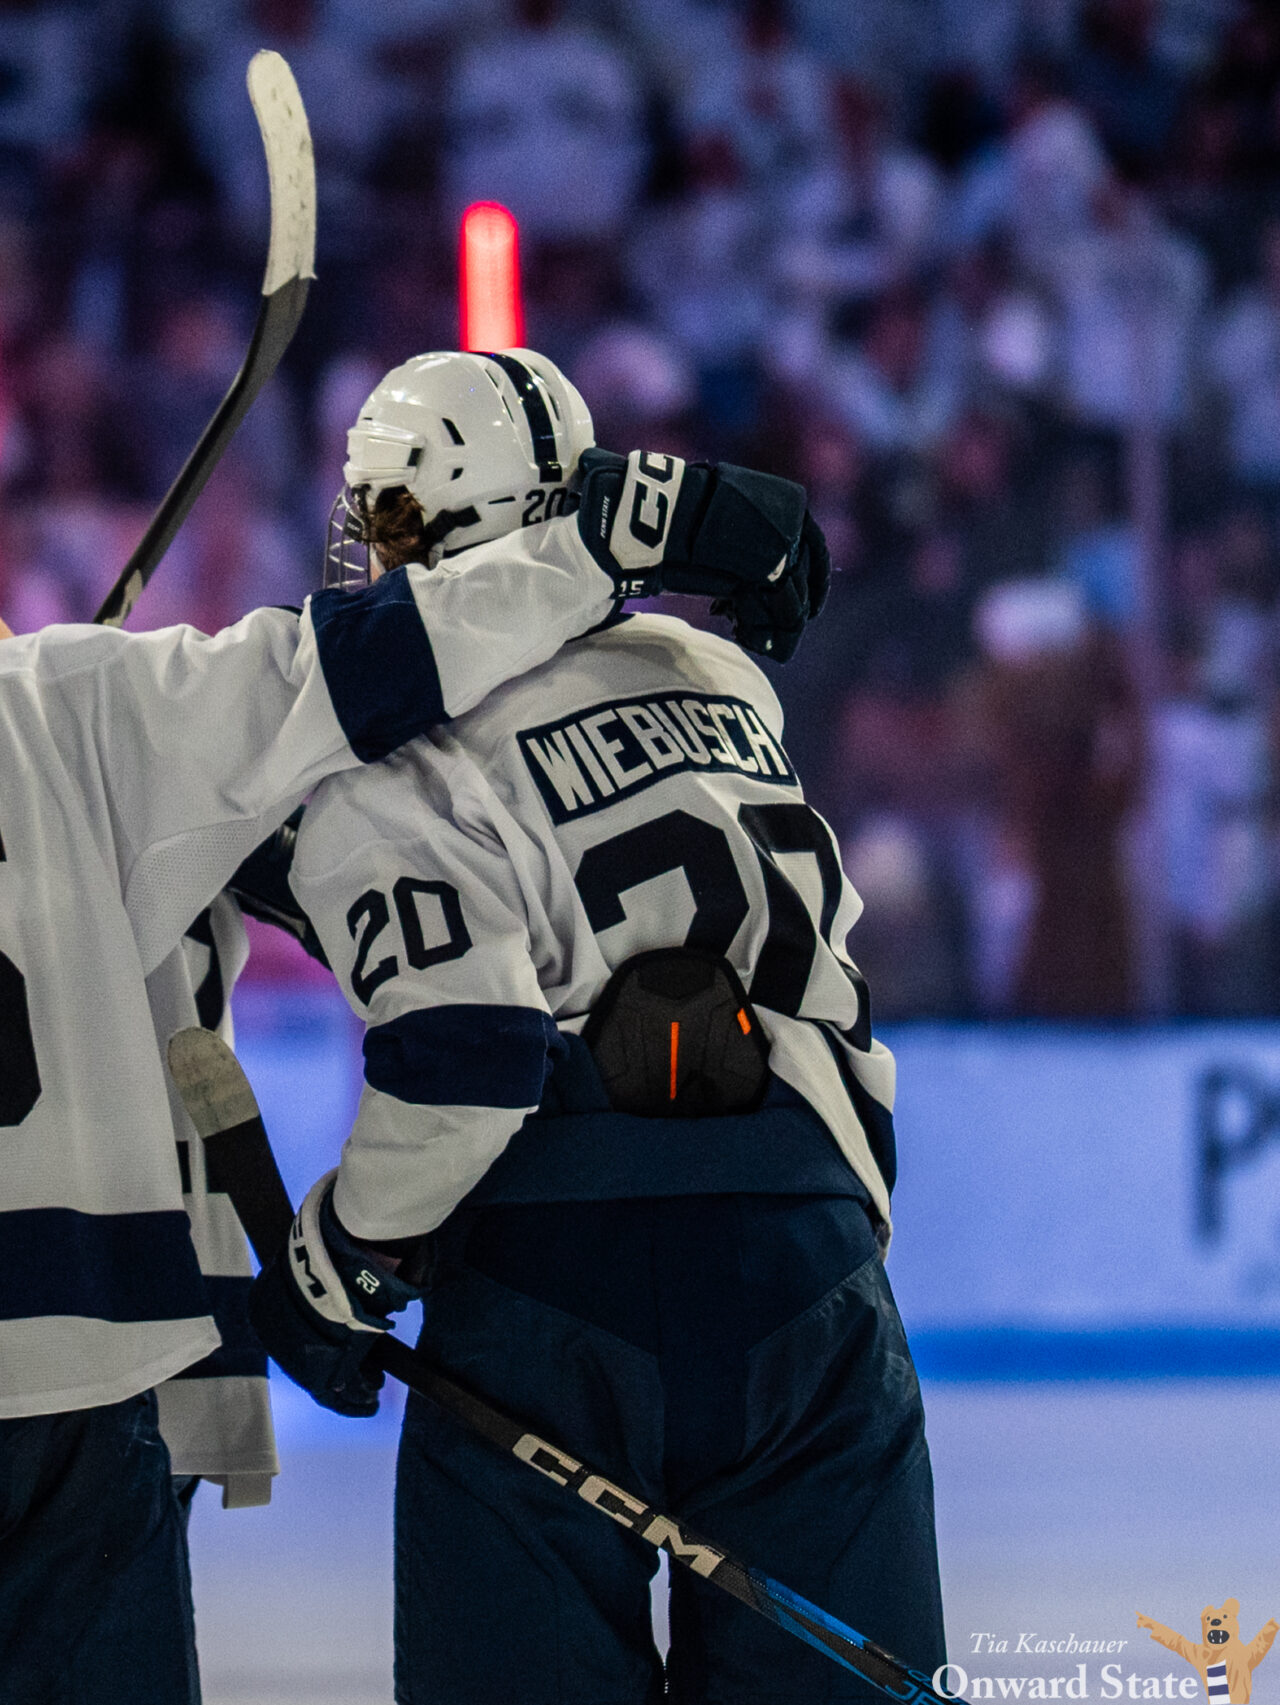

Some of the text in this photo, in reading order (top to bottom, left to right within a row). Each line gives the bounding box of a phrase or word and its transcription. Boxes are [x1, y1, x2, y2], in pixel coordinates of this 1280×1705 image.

[522, 486, 568, 527] 20
[618, 580, 645, 597] 15
[527, 699, 790, 812] WIEBUSCH
[346, 876, 474, 1007] 20
[356, 1269, 381, 1295] 20
[512, 1433, 726, 1578] CCM
